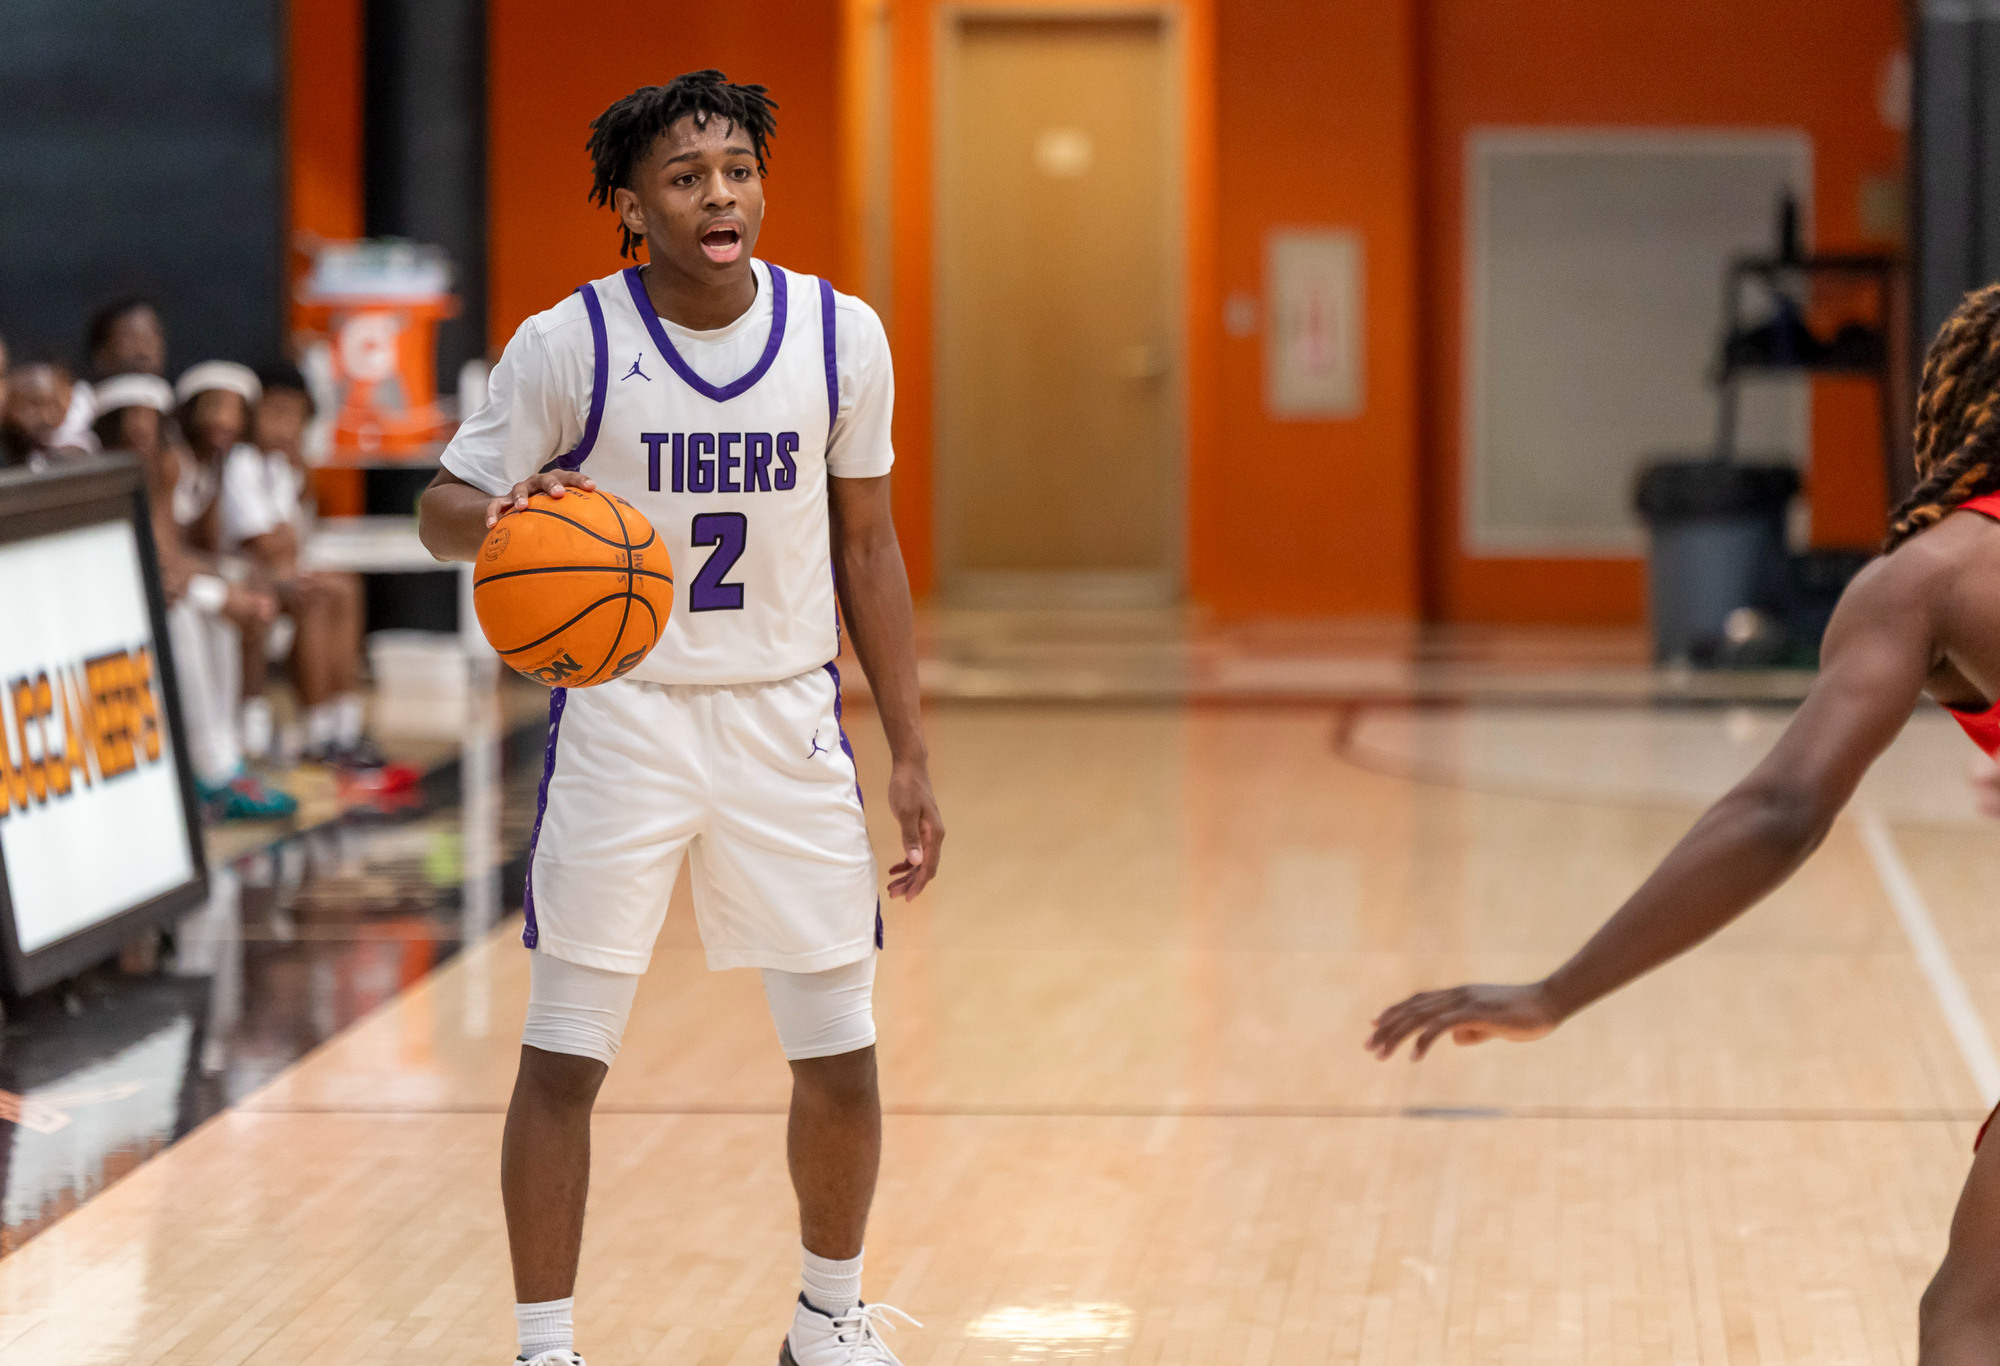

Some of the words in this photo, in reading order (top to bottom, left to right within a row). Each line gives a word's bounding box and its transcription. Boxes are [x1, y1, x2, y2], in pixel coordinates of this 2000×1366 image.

[641, 431, 800, 493] TIGERS
[689, 511, 748, 613] 2
[0, 643, 161, 818] UCCANEERS
